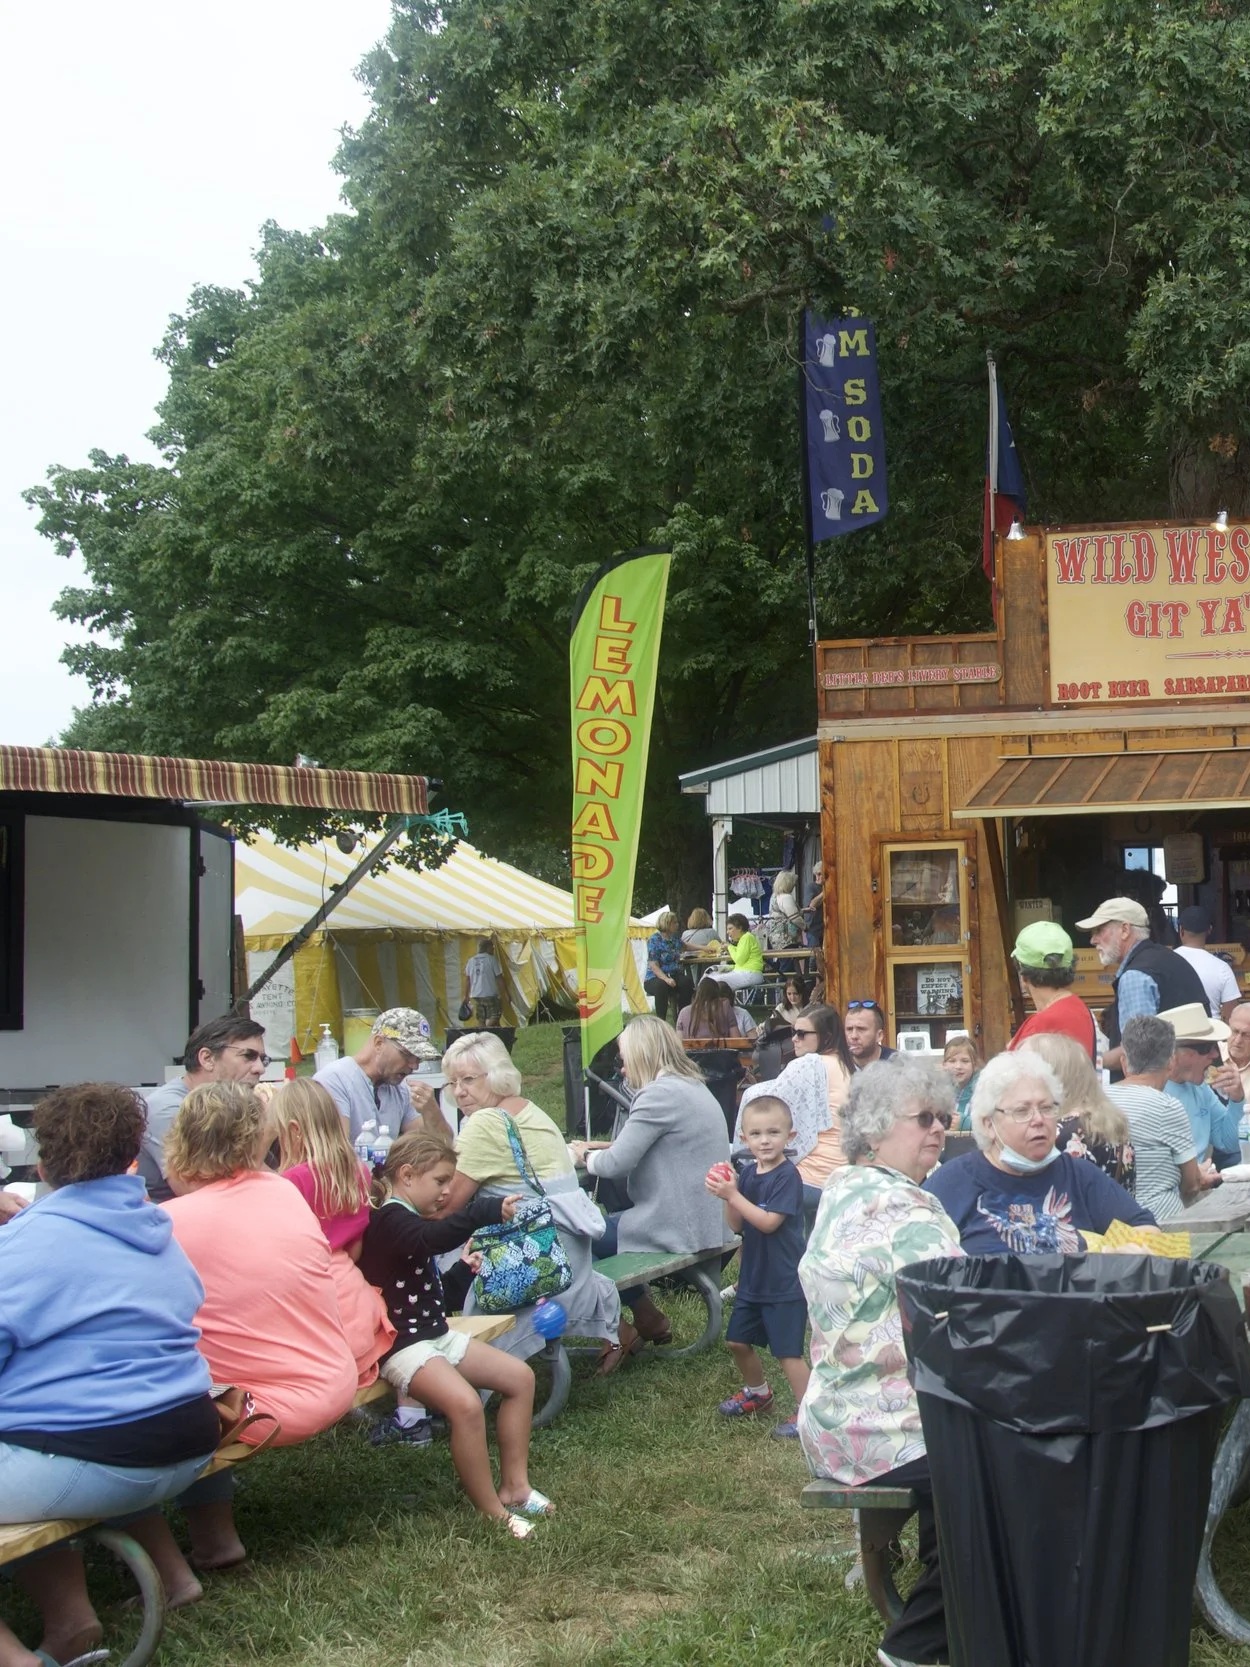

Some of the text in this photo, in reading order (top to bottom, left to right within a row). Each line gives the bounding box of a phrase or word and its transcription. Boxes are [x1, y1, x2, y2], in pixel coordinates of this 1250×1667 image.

[843, 378, 880, 515] SODA
[1052, 530, 1158, 584] WILD
[1124, 599, 1190, 639] GIT
[825, 665, 996, 686] LITTLE DEB'S LIVERY STABLE
[1057, 681, 1102, 700] ROOT
[1108, 679, 1151, 698] BEER
[572, 594, 638, 925] LEMONADE
